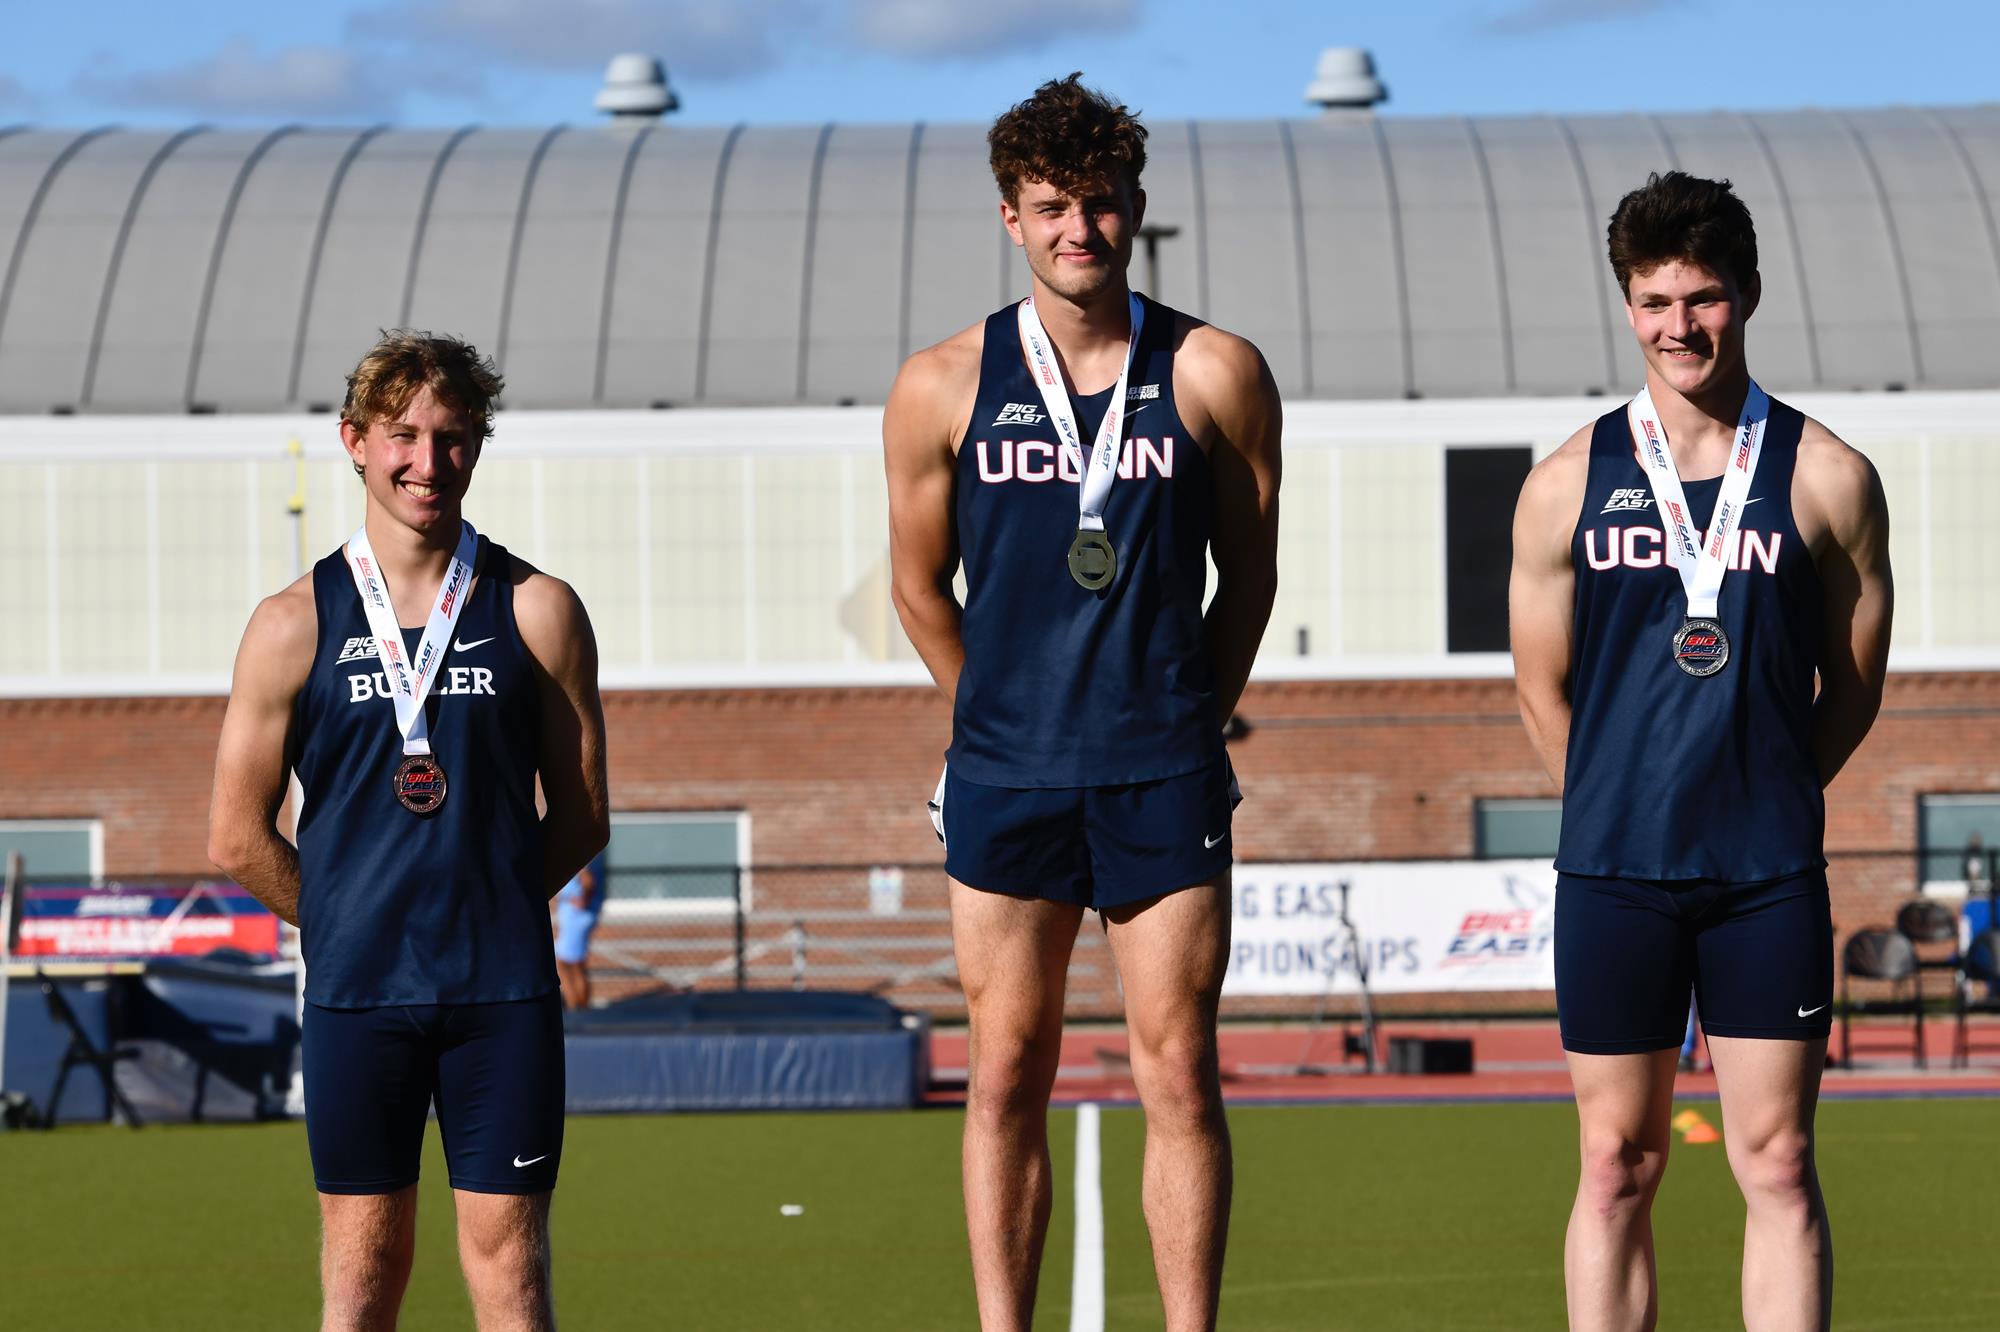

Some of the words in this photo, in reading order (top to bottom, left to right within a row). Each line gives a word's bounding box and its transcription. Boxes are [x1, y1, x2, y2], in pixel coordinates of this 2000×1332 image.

[1030, 335, 1046, 365] EAST
[1040, 366, 1052, 385] BIG
[1002, 402, 1038, 413] BIG
[1126, 393, 1160, 401] HANGE
[996, 412, 1046, 424] EAST
[1108, 411, 1117, 433] BIG
[1646, 420, 1657, 439] BIG
[1058, 416, 1077, 448] EAST
[1741, 415, 1754, 448] EAST
[1103, 433, 1114, 470] EAST
[1651, 439, 1668, 471] EAST
[1736, 446, 1747, 469] BIG
[1604, 499, 1655, 509] EAST
[1609, 488, 1646, 499] BIG
[1671, 502, 1685, 524] BIG
[1678, 524, 1697, 559] EAST
[1710, 535, 1721, 558] BIG
[1717, 500, 1731, 536] EAST
[1584, 526, 1783, 575] UCN
[361, 557, 374, 577] BIG
[368, 577, 385, 608] EAST
[440, 591, 453, 614] BIG
[448, 560, 463, 594] EAST
[1681, 645, 1723, 654] EAST
[1685, 635, 1717, 645] BIG
[338, 648, 379, 659] EAS
[418, 640, 433, 675] EAST
[388, 640, 401, 661] BIG
[396, 661, 411, 696] EAST
[348, 667, 496, 703] BUER
[402, 782, 440, 791] EAST
[406, 773, 434, 782] BIG
[1459, 910, 1534, 934] BIG
[1234, 939, 1420, 975] PIONSHIPS
